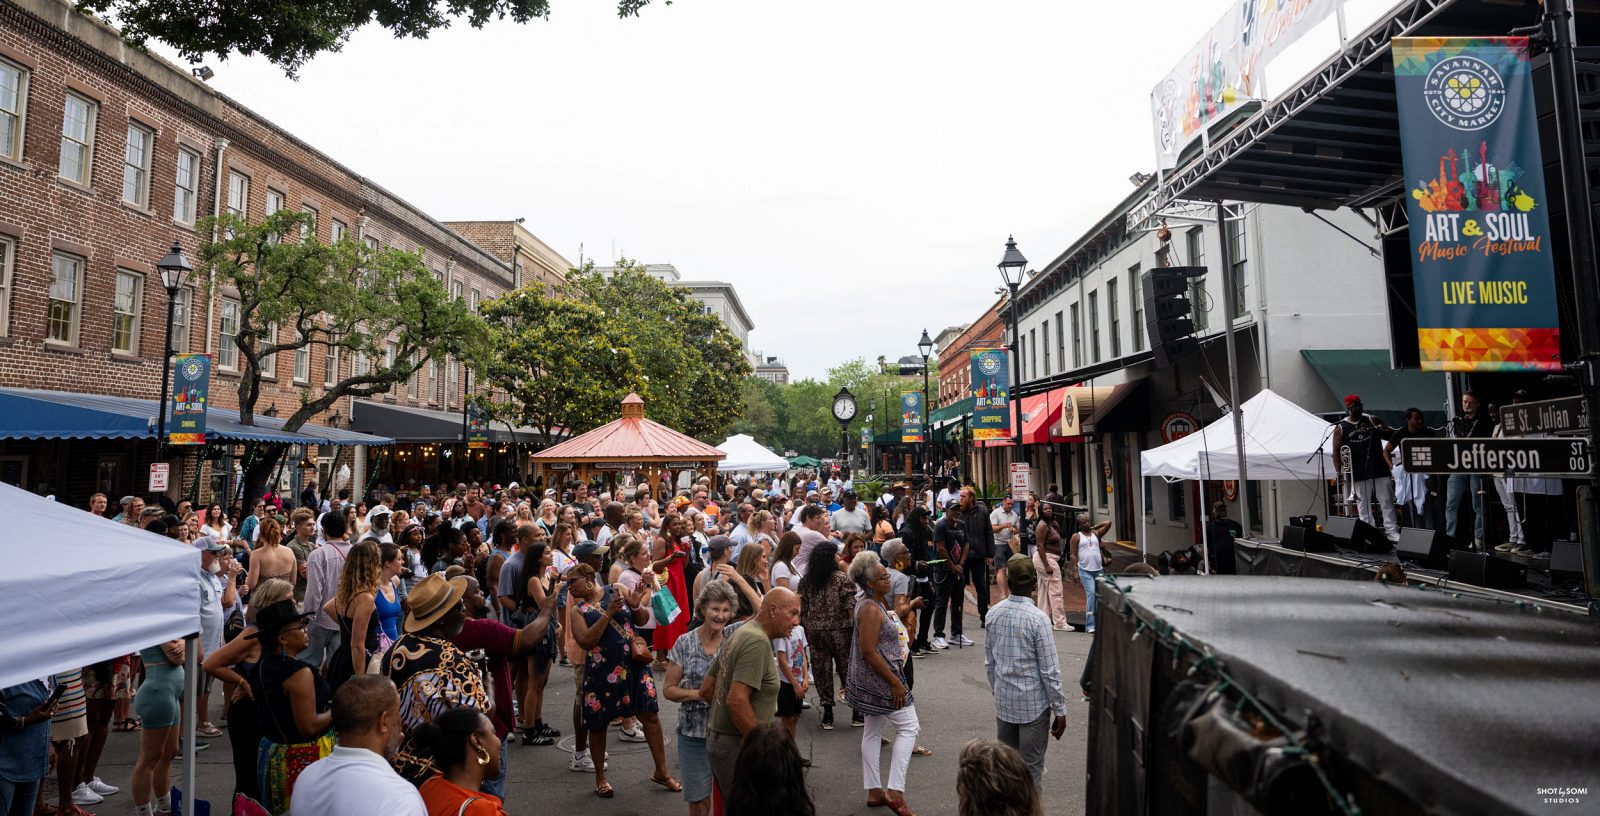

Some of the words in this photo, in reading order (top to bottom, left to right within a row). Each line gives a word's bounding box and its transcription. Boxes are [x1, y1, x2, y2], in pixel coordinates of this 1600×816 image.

[1431, 60, 1498, 85] SAVANNAH
[1432, 98, 1455, 122] CITY
[1458, 98, 1500, 127] MARKET
[1425, 213, 1459, 241] ART
[1462, 219, 1483, 236] &
[1485, 212, 1535, 241] SOUL
[1418, 240, 1469, 262] Music
[1473, 235, 1542, 257] Festival
[1442, 281, 1477, 305] LIVE
[1479, 280, 1528, 305] MUSIC
[1518, 408, 1532, 432] St.
[1537, 404, 1570, 430] Julian
[1447, 443, 1540, 469] Jefferson
[1571, 442, 1583, 455] ST
[1569, 456, 1585, 471] 00
